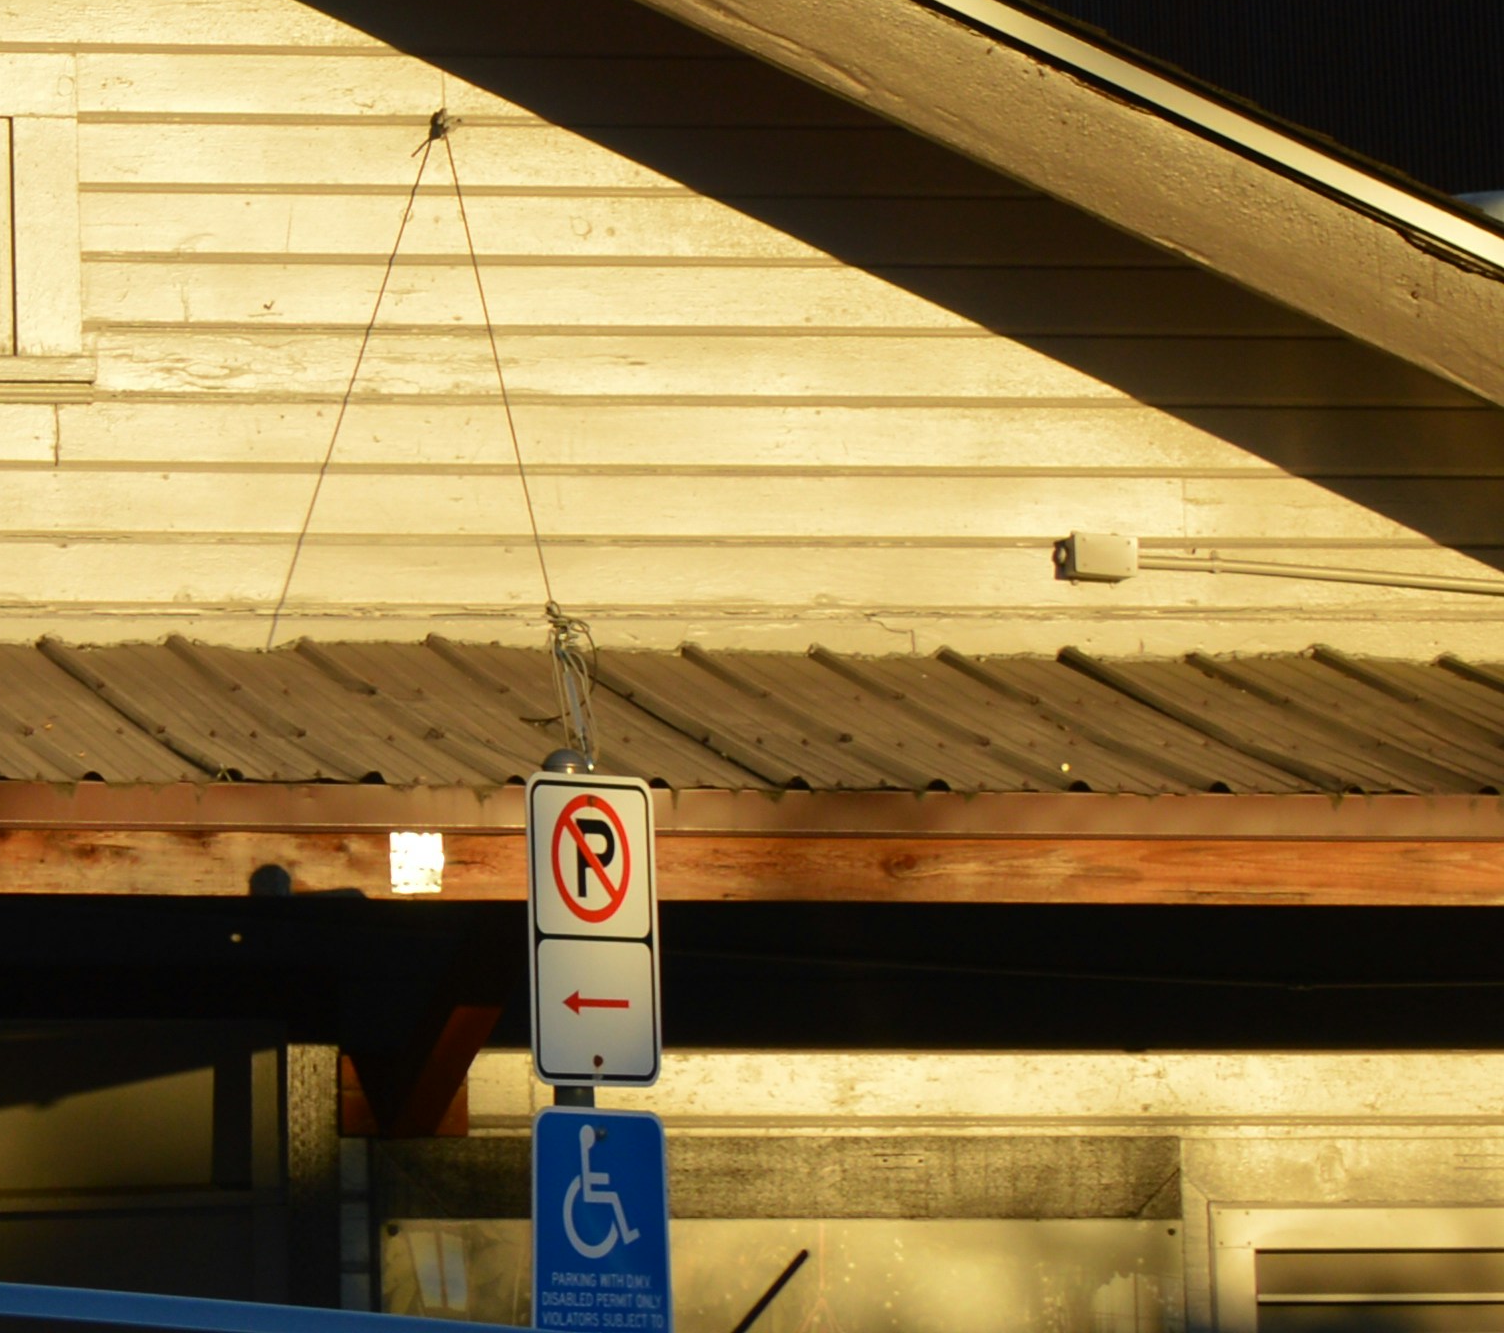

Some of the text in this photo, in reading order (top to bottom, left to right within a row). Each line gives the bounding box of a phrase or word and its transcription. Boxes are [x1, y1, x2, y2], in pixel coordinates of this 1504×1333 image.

[575, 817, 615, 899] P
[551, 1271, 598, 1288] PARKING
[600, 1273, 625, 1289] WITH
[541, 1290, 664, 1310] DISABLED PERMIT ONLY
[541, 1310, 666, 1331] VIOLATORS SUBJECT TO
